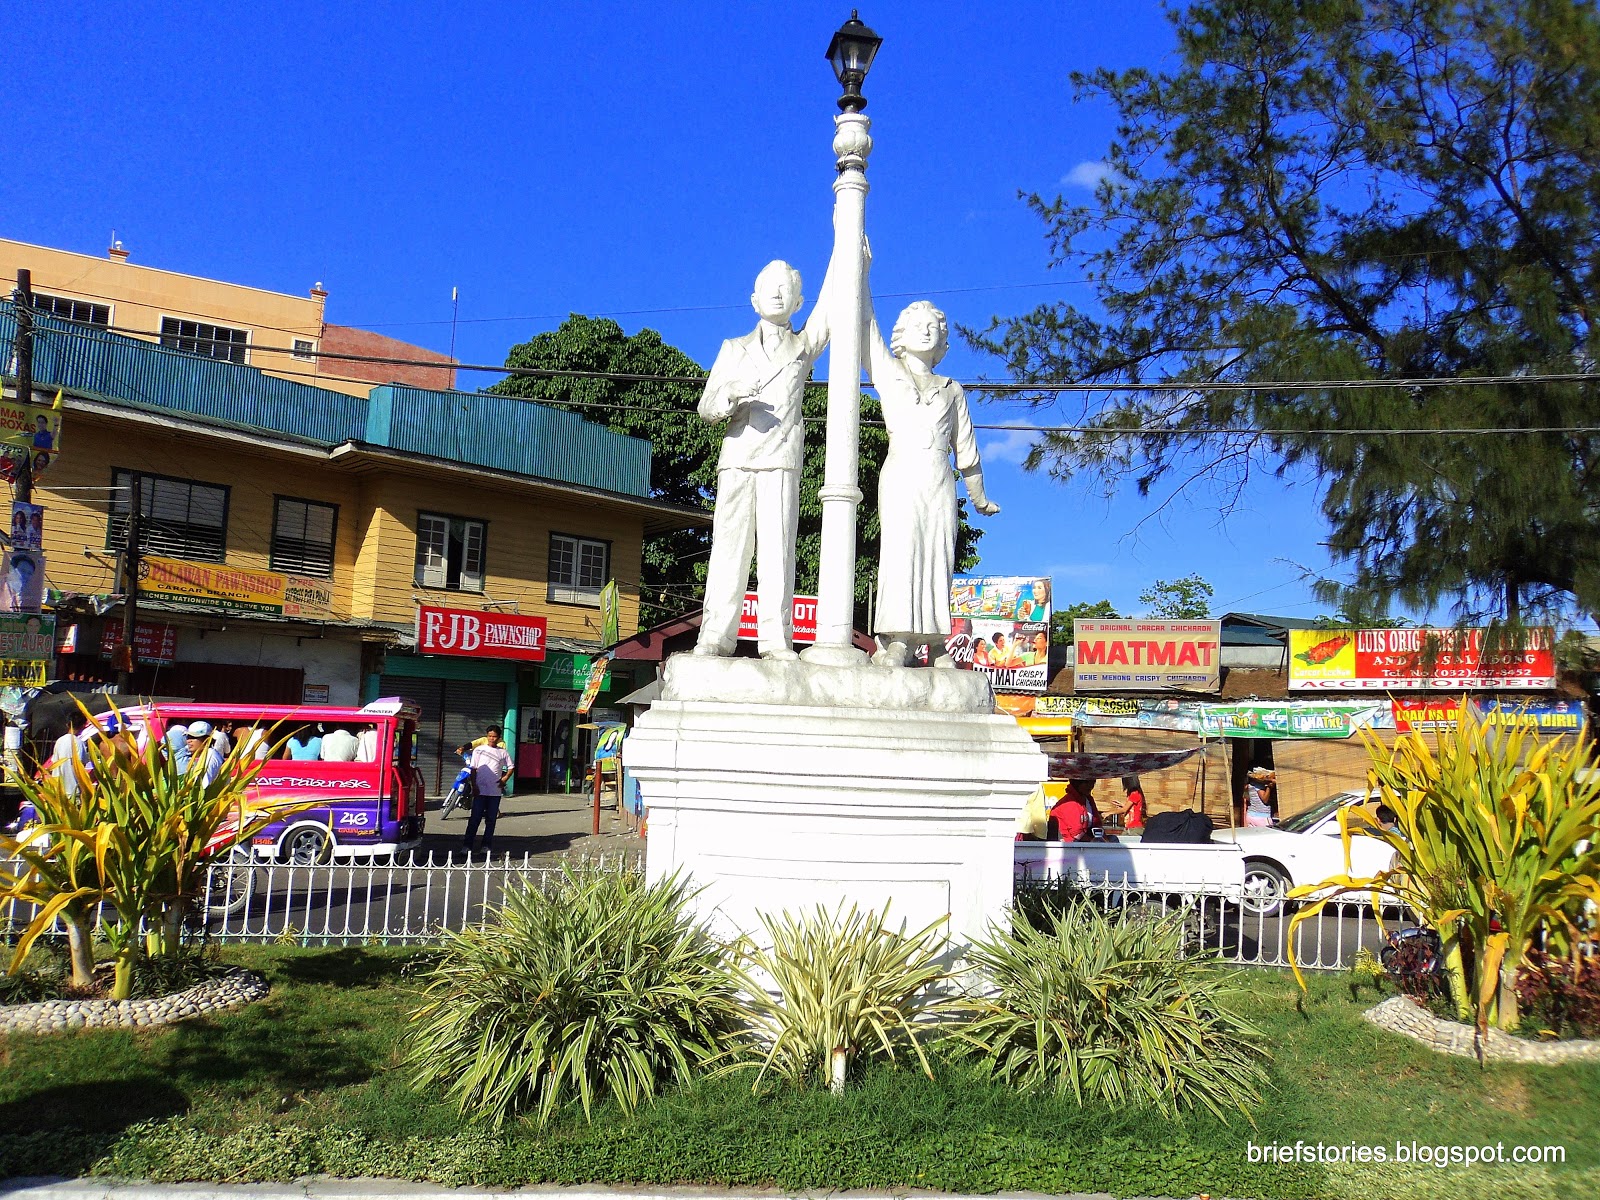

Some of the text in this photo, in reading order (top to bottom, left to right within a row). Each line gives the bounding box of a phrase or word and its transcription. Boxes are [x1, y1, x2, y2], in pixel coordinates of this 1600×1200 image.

[0, 407, 25, 421] MAR
[0, 418, 37, 434] ROXAS
[152, 562, 211, 588] PALAWAN
[215, 570, 283, 596] PAWNSHOP
[157, 583, 250, 599] CARCAR BRANCH
[172, 595, 220, 606] NATIONWIDE
[423, 611, 543, 651] FJB PAWNSHOP
[1100, 624, 1133, 632] ORIGINAL
[1357, 631, 1385, 653] LUIS
[1389, 630, 1421, 653] ORIG
[1077, 640, 1217, 667] MATMAT
[1373, 656, 1407, 666] AND
[995, 668, 1016, 686] MAT
[1018, 669, 1044, 679] CRISPY
[1016, 678, 1048, 688] CHICHARON
[1135, 674, 1161, 682] CRISPY
[1300, 680, 1419, 688] ACCEPT
[1097, 698, 1139, 711] LACSON
[339, 811, 369, 826] 46
